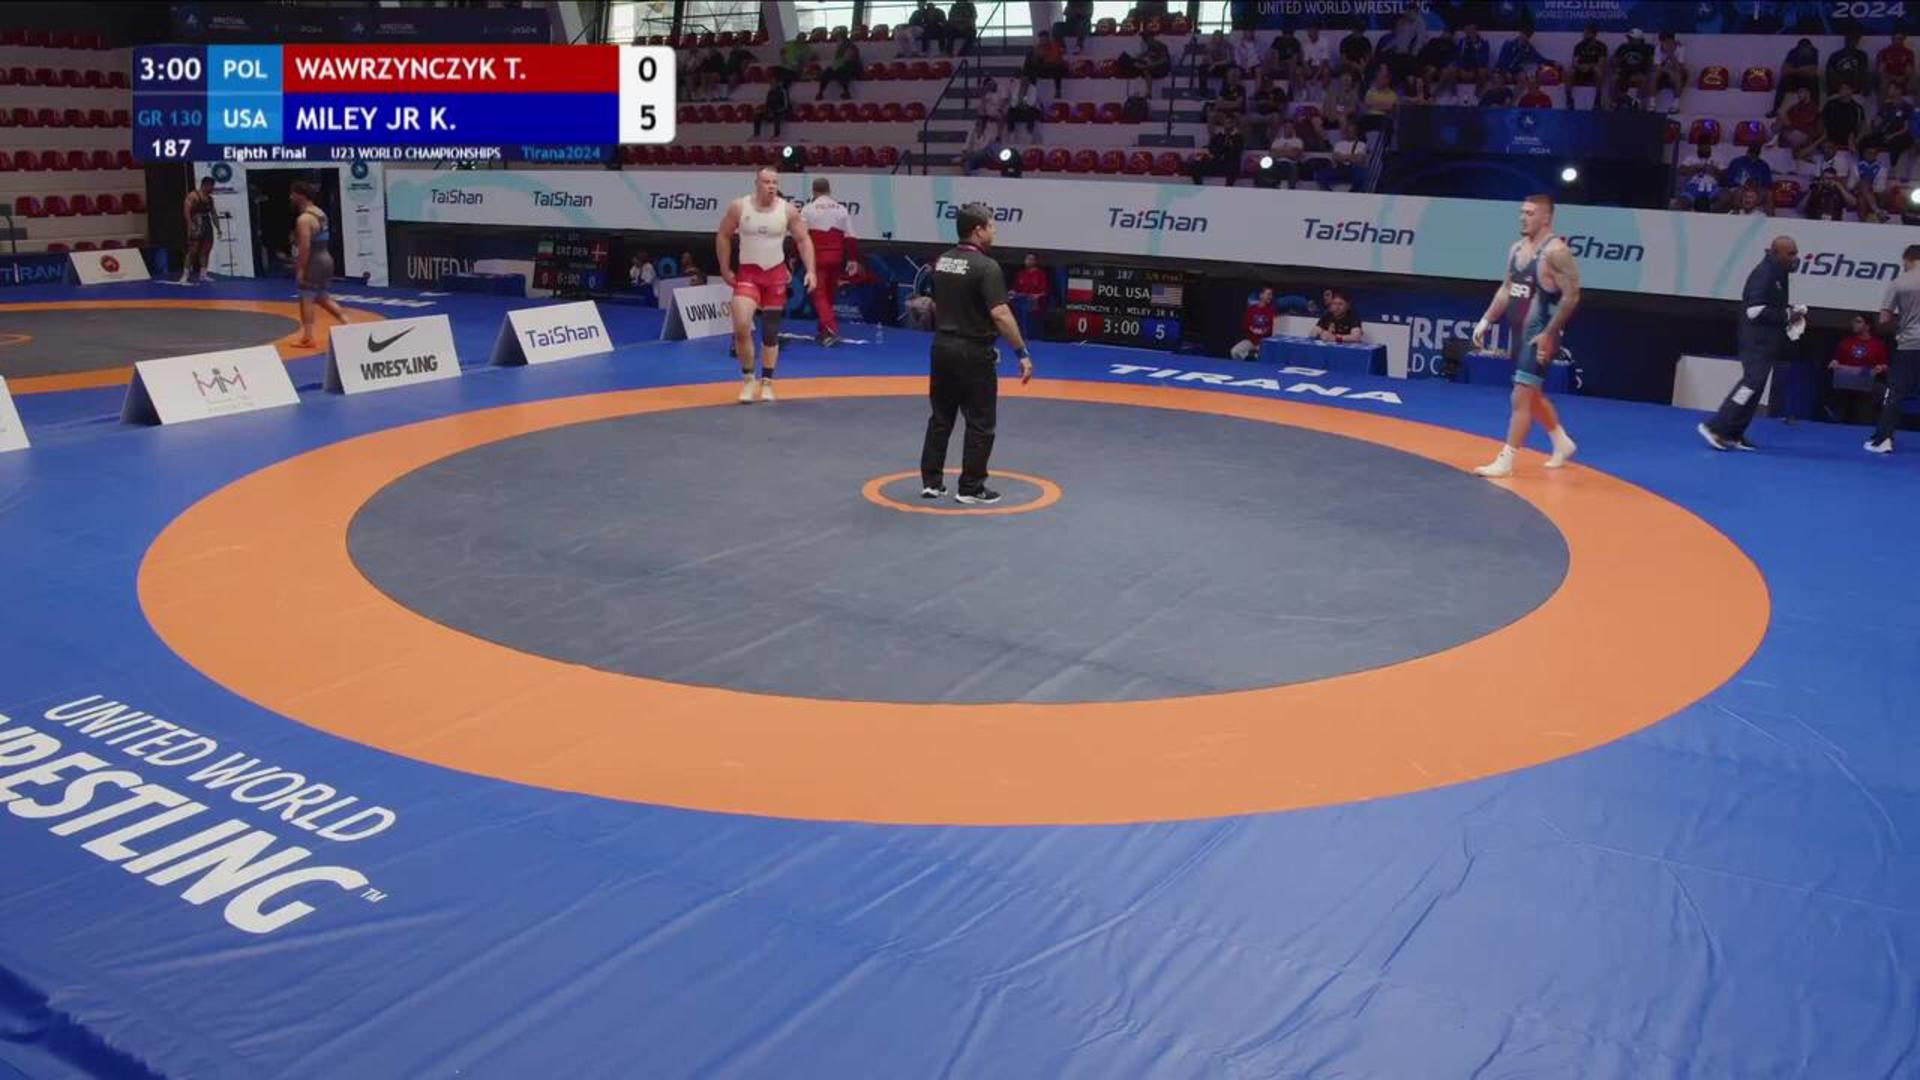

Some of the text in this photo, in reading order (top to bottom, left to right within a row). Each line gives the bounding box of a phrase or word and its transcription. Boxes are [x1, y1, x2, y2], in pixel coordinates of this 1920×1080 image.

[1257, 0, 1431, 14] UNITED WORLD WRESTLG
[1831, 1, 1904, 19] 2024
[431, 189, 484, 205] TaiShan
[533, 191, 593, 208] TaiShan
[650, 193, 717, 210] TaiShan
[935, 200, 1023, 223] Taan
[1108, 207, 1208, 233] TaiShan
[1303, 218, 1415, 247] TaiShan
[1560, 235, 1644, 262] Shan
[0, 263, 62, 284] TIRAN
[407, 256, 461, 280] UNITED
[1793, 253, 1900, 281] iShan
[1098, 285, 1151, 300] POL USA
[1511, 281, 1531, 299] SA
[686, 302, 733, 322] UWW.O
[525, 325, 600, 348] TaiShan
[1078, 317, 1088, 334] 0
[1103, 318, 1140, 336] 3:00
[1155, 324, 1165, 340] 5
[360, 355, 439, 381] WRESTLING
[1108, 363, 1403, 405] TIRANA
[44, 694, 218, 767] UNITED
[186, 752, 396, 842] WORLD
[0, 713, 369, 934] ESTLING
